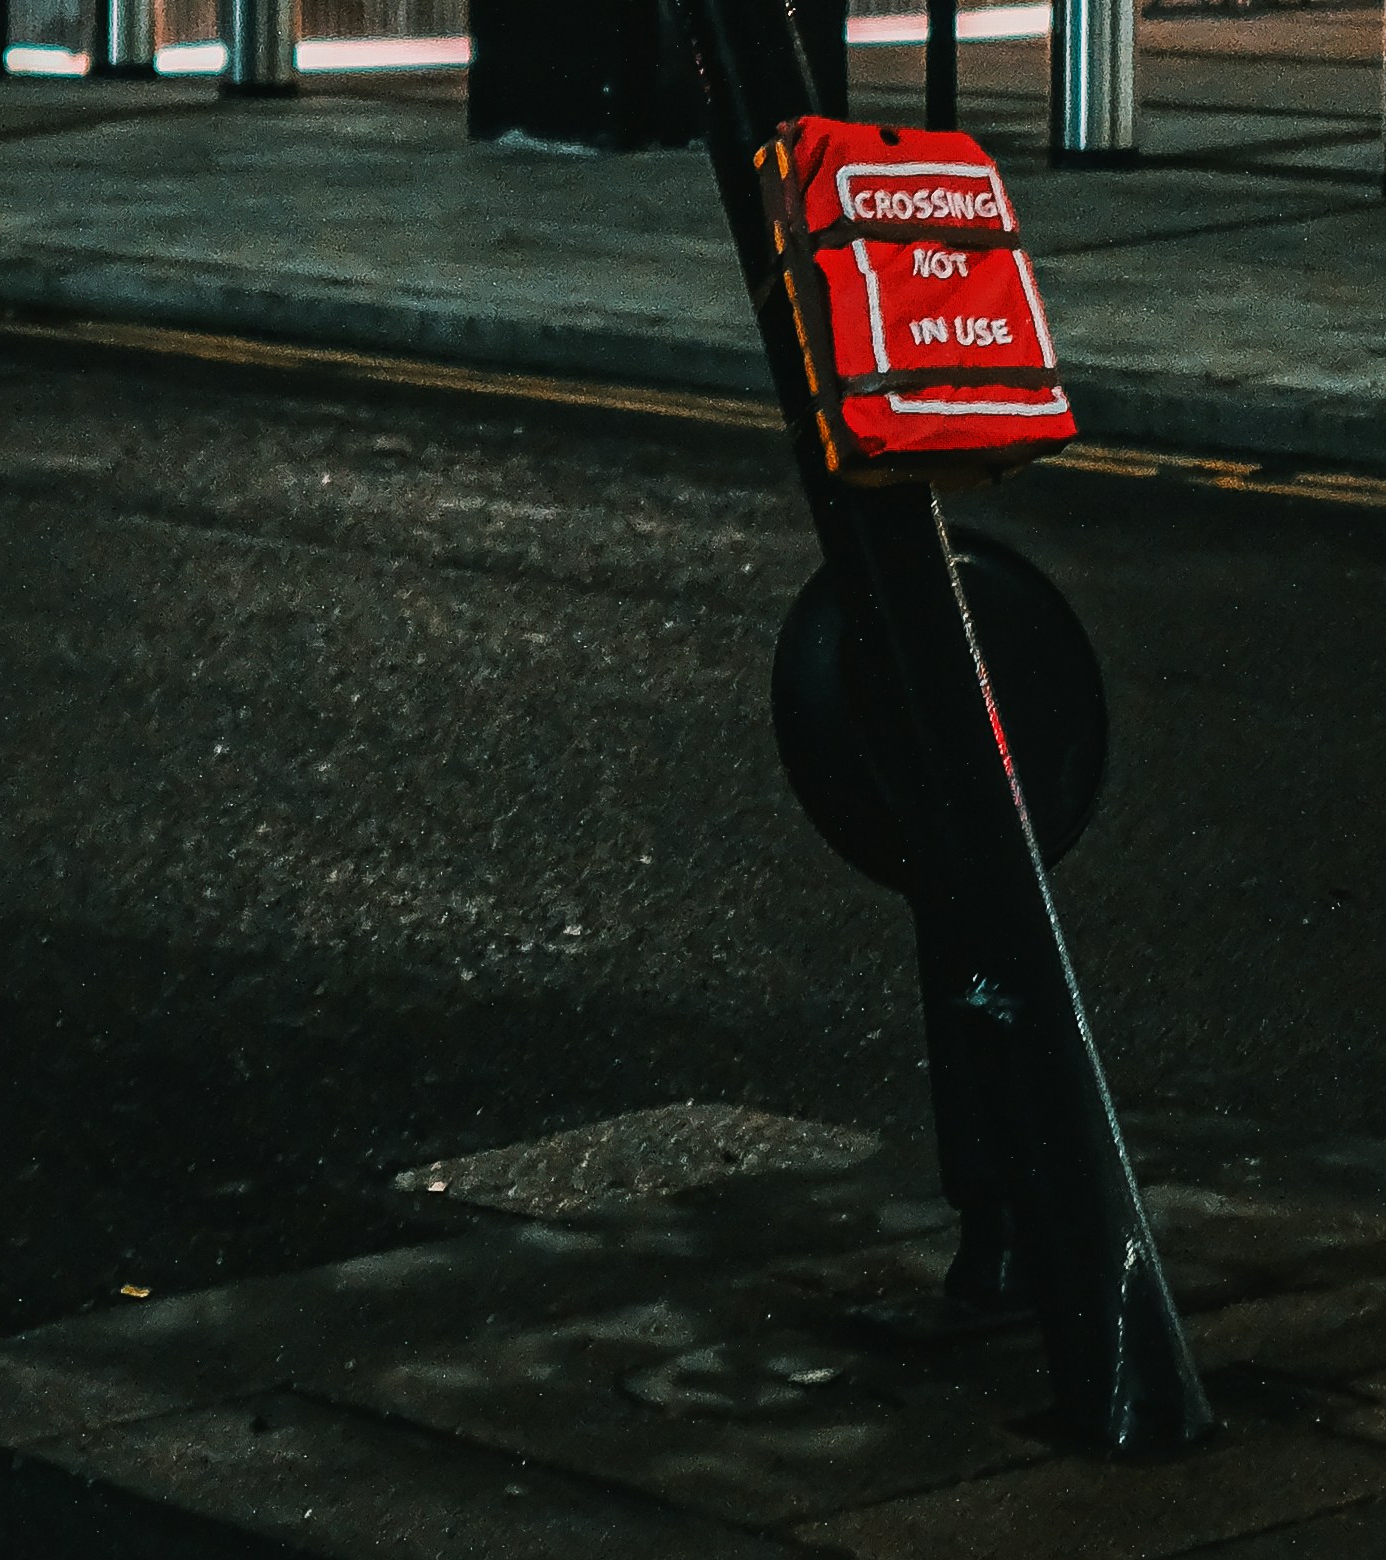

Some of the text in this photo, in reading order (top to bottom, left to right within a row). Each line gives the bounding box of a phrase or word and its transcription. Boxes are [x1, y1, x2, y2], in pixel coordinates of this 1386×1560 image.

[853, 187, 999, 220] CROSSING
[913, 248, 968, 279] NOT
[909, 315, 1013, 346] IN USE
